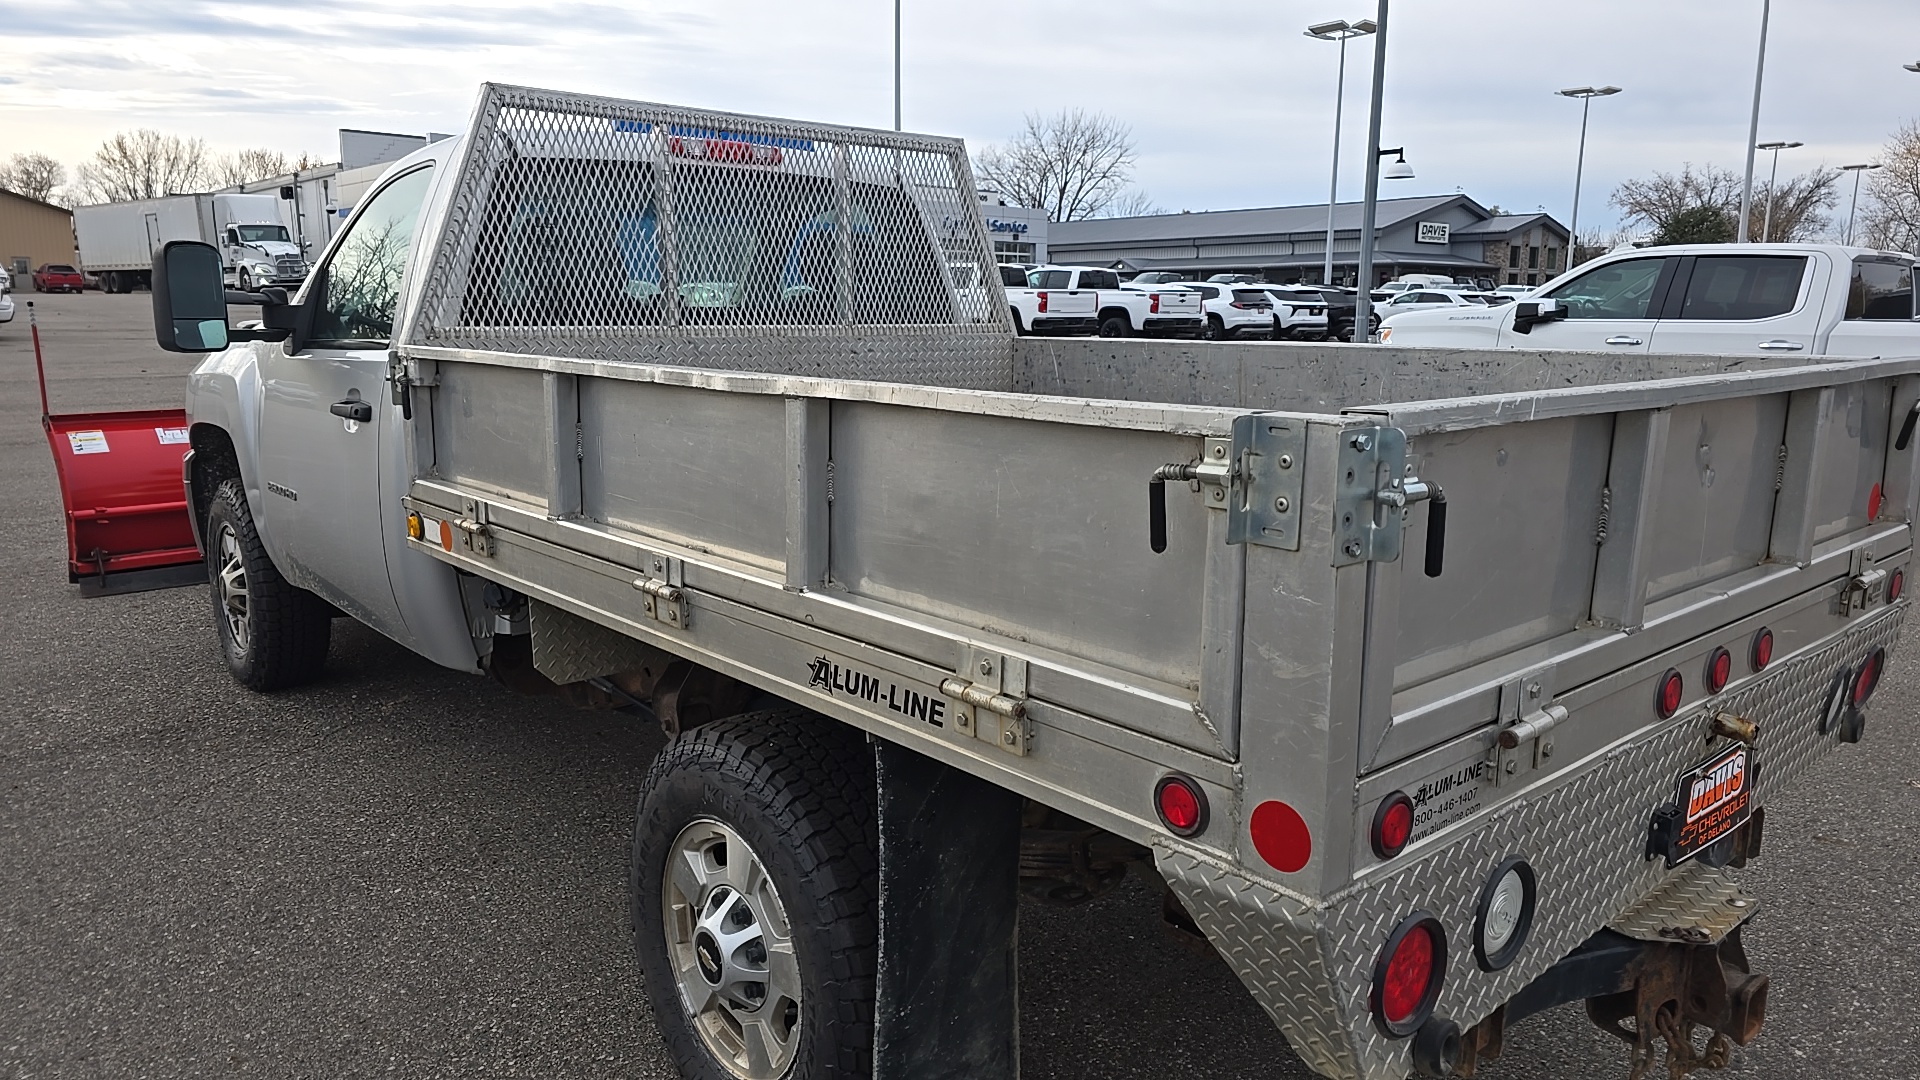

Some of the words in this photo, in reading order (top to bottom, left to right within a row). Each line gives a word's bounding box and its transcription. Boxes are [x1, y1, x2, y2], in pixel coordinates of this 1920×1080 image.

[990, 219, 1028, 234] Service
[1421, 224, 1447, 236] DAVIS
[806, 655, 946, 729] ALUM-LINE
[1412, 761, 1484, 808] ALUM-LINE
[1689, 753, 1745, 818] DAVIS
[1414, 787, 1479, 827] 800-446-1407
[1698, 791, 1750, 833] CHEVROLET
[1698, 832, 1707, 845] OF
[1707, 819, 1731, 840] DELANO
